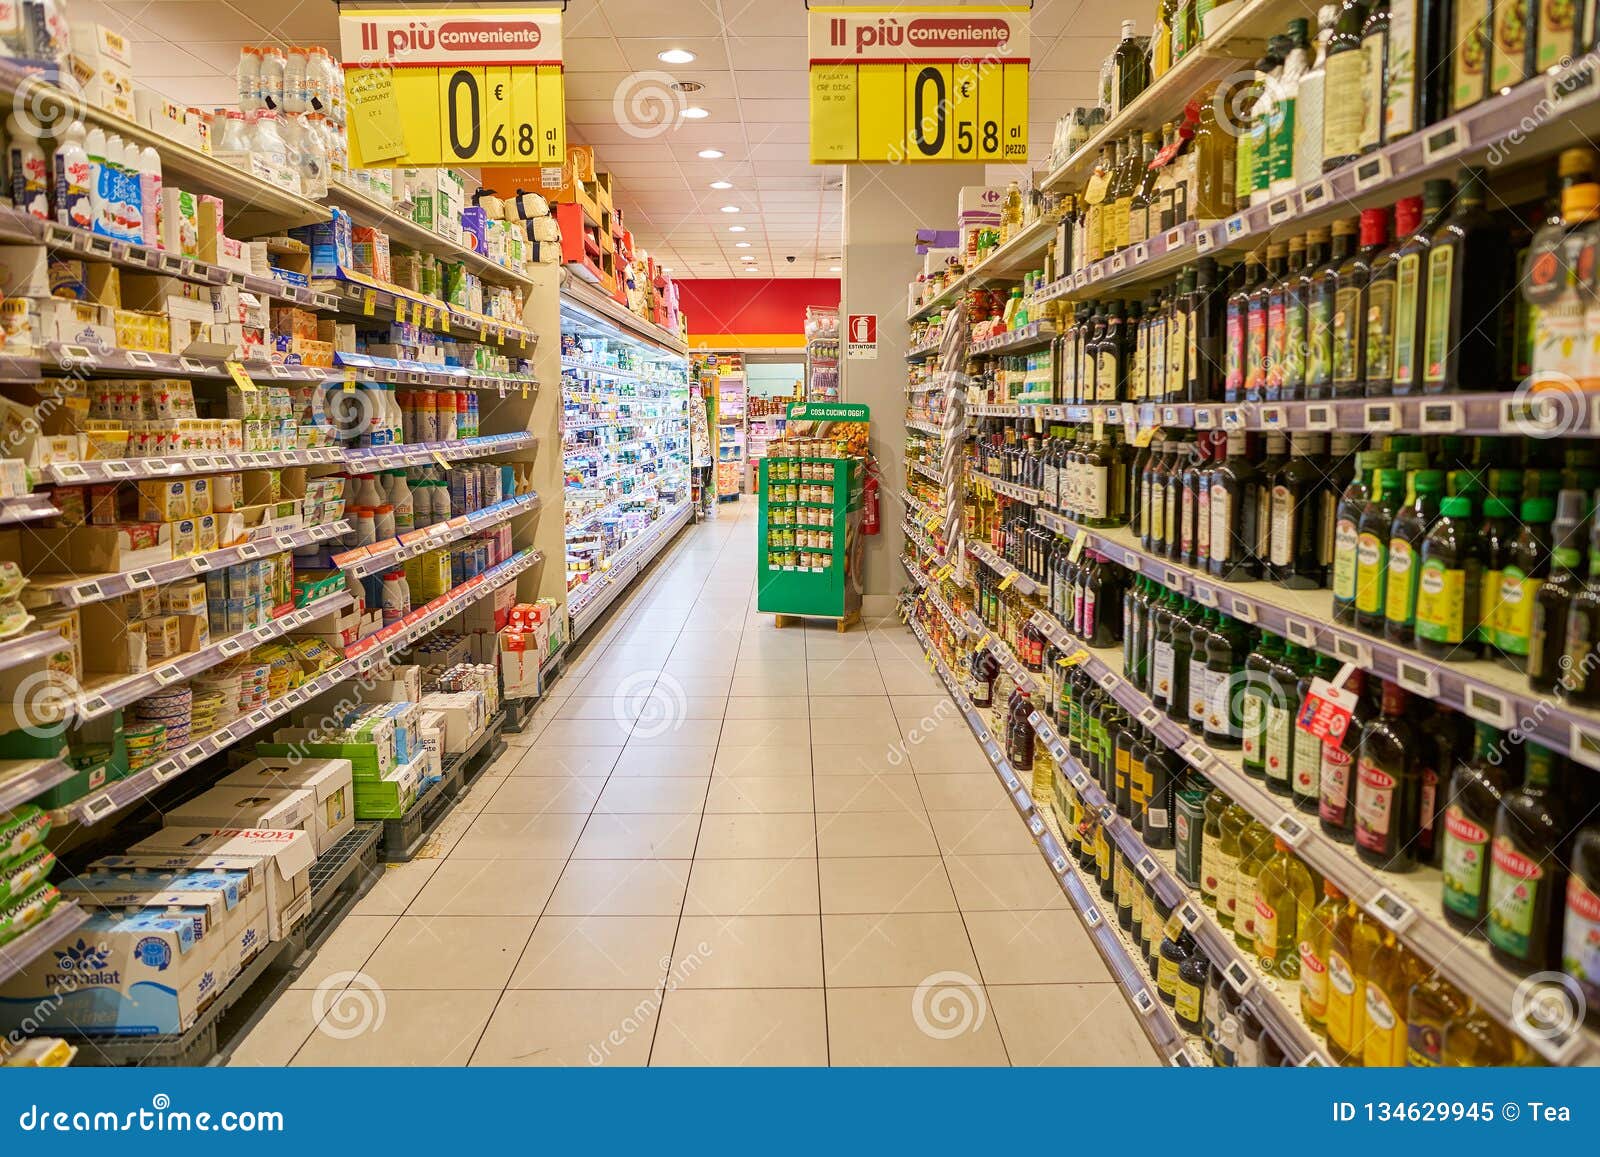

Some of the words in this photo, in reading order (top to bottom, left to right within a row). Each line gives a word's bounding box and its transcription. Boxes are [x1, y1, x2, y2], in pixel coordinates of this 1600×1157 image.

[361, 22, 377, 50] Il
[388, 22, 435, 58] più
[440, 28, 540, 44] conveniente
[831, 19, 846, 46] Il
[856, 18, 904, 53] più
[909, 25, 1009, 40] conveniente
[448, 70, 480, 159] 0
[915, 66, 946, 156] 0
[546, 127, 557, 141] al
[1010, 125, 1020, 138] al
[1005, 143, 1026, 156] pezzo
[810, 408, 825, 416] COSA
[826, 409, 846, 417] CUCINO
[213, 829, 295, 842] VITASOYA
